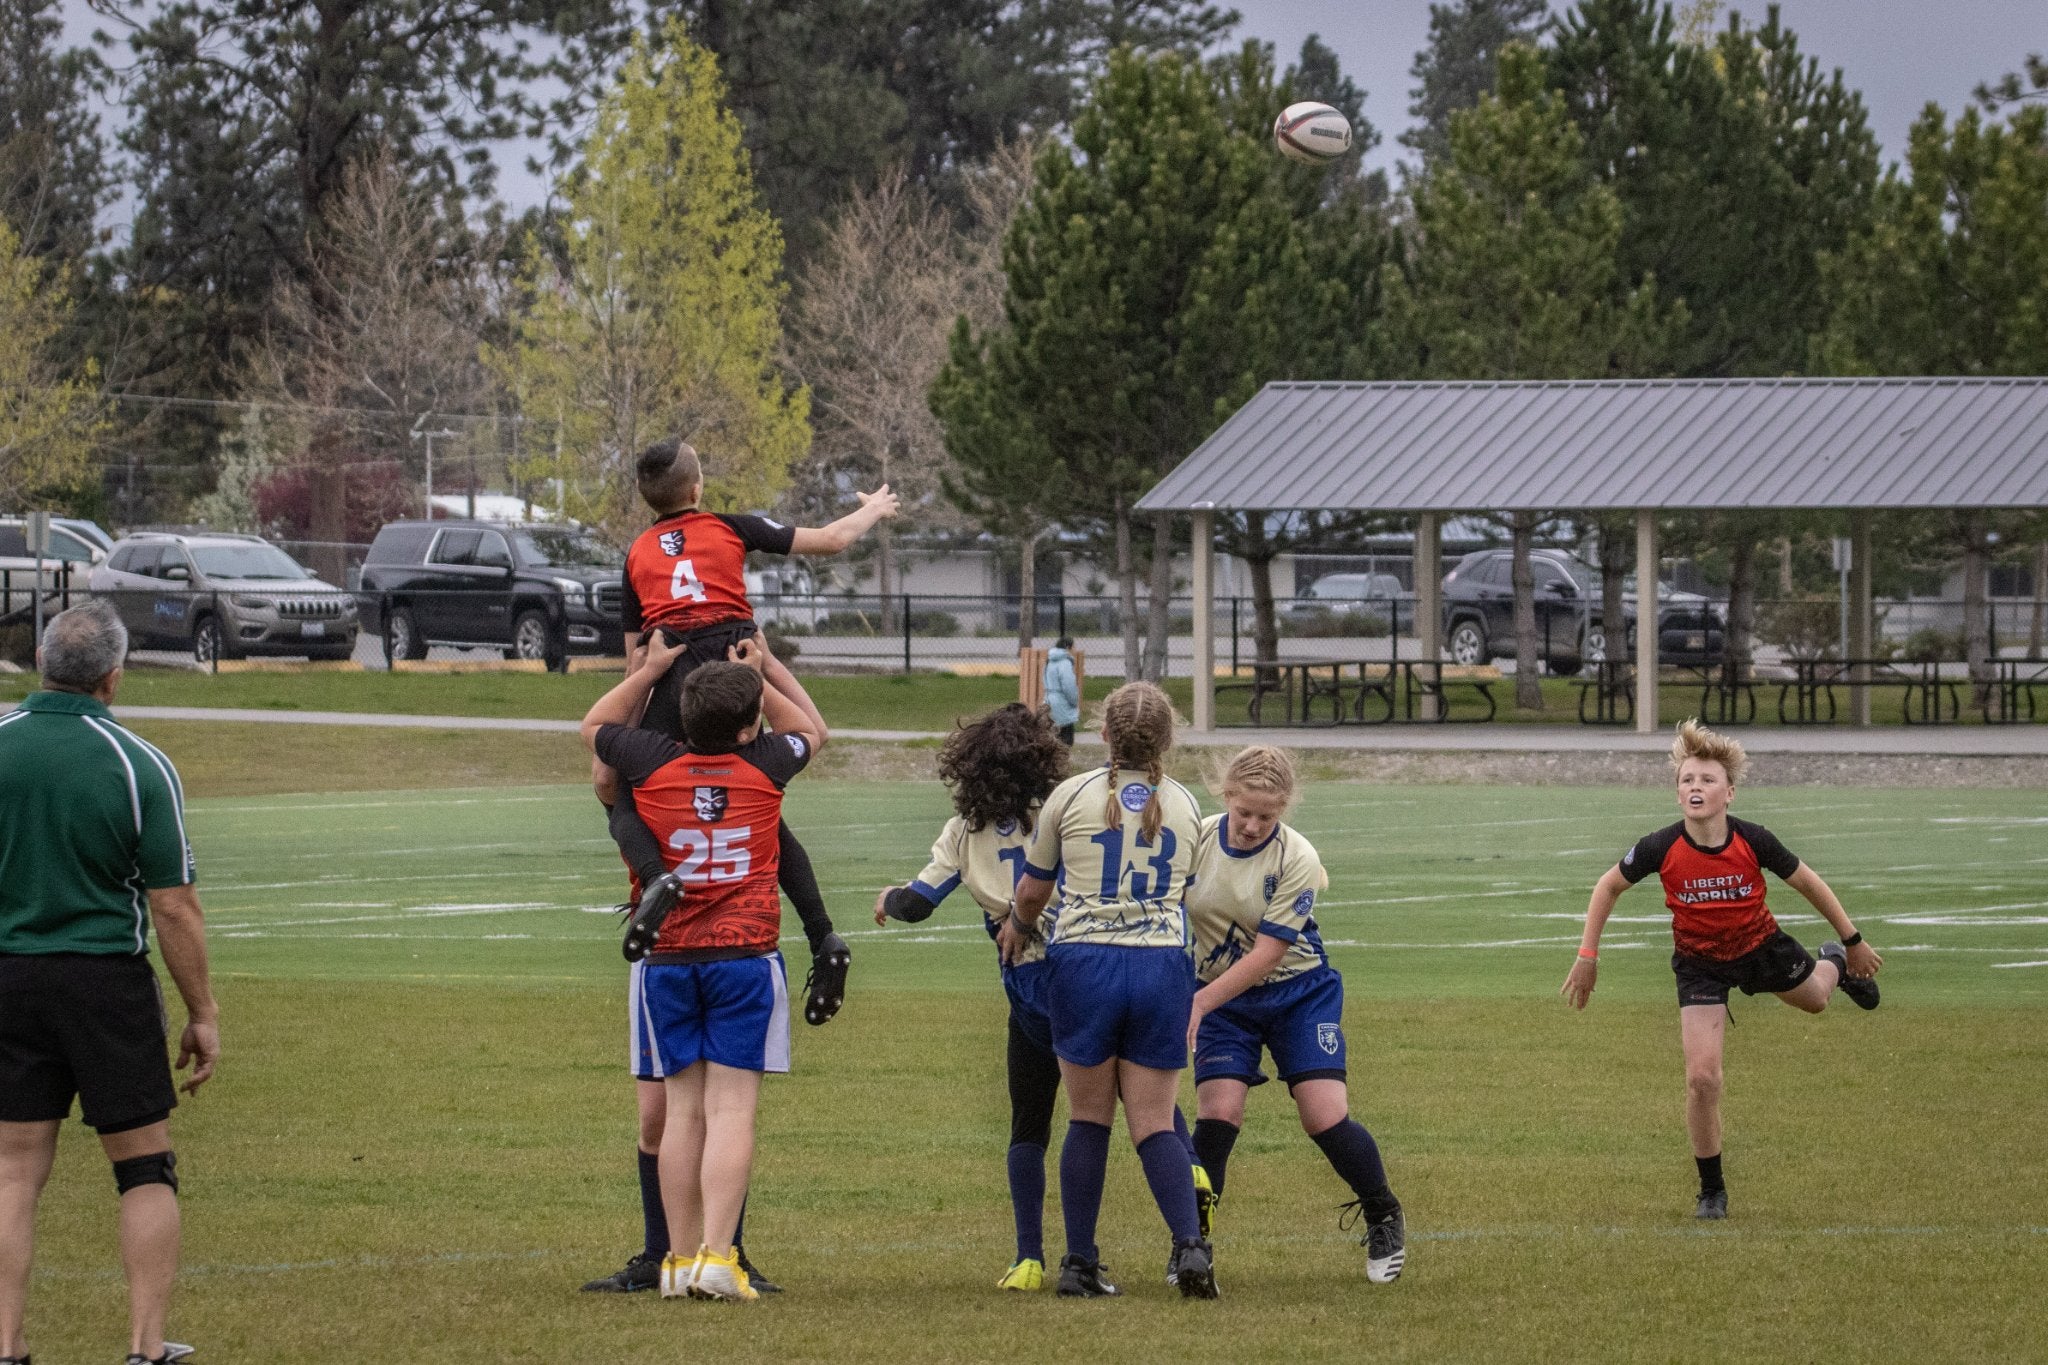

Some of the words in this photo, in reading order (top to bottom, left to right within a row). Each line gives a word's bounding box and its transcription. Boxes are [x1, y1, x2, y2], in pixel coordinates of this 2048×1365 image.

[670, 559, 707, 602] 4
[669, 826, 751, 884] 25
[1091, 823, 1177, 905] 13
[1684, 874, 1743, 889] LIBERTY
